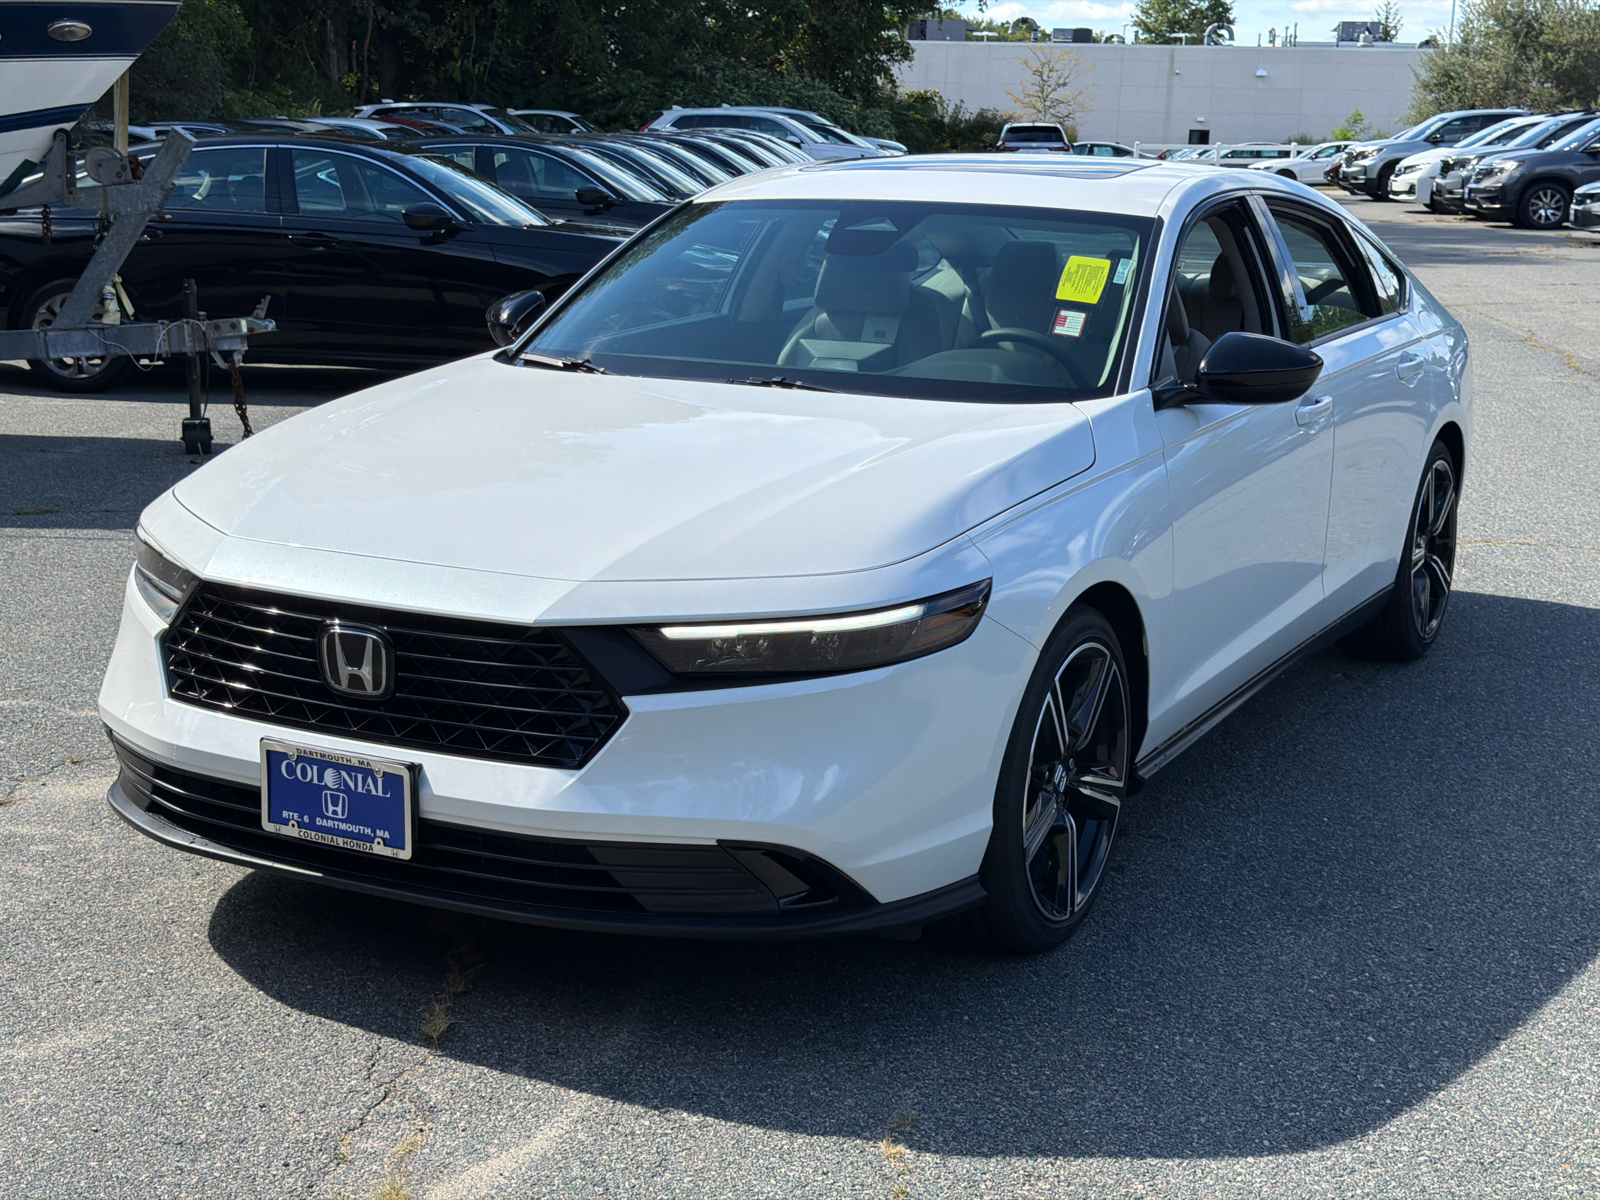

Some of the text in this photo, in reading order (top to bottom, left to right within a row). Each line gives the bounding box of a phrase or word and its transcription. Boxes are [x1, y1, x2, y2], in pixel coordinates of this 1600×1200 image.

[281, 760, 391, 798] COLONIAL
[282, 810, 390, 839] RTE. 6 DARTMOUTH, MA
[298, 830, 374, 852] COLONIAL HONDA
